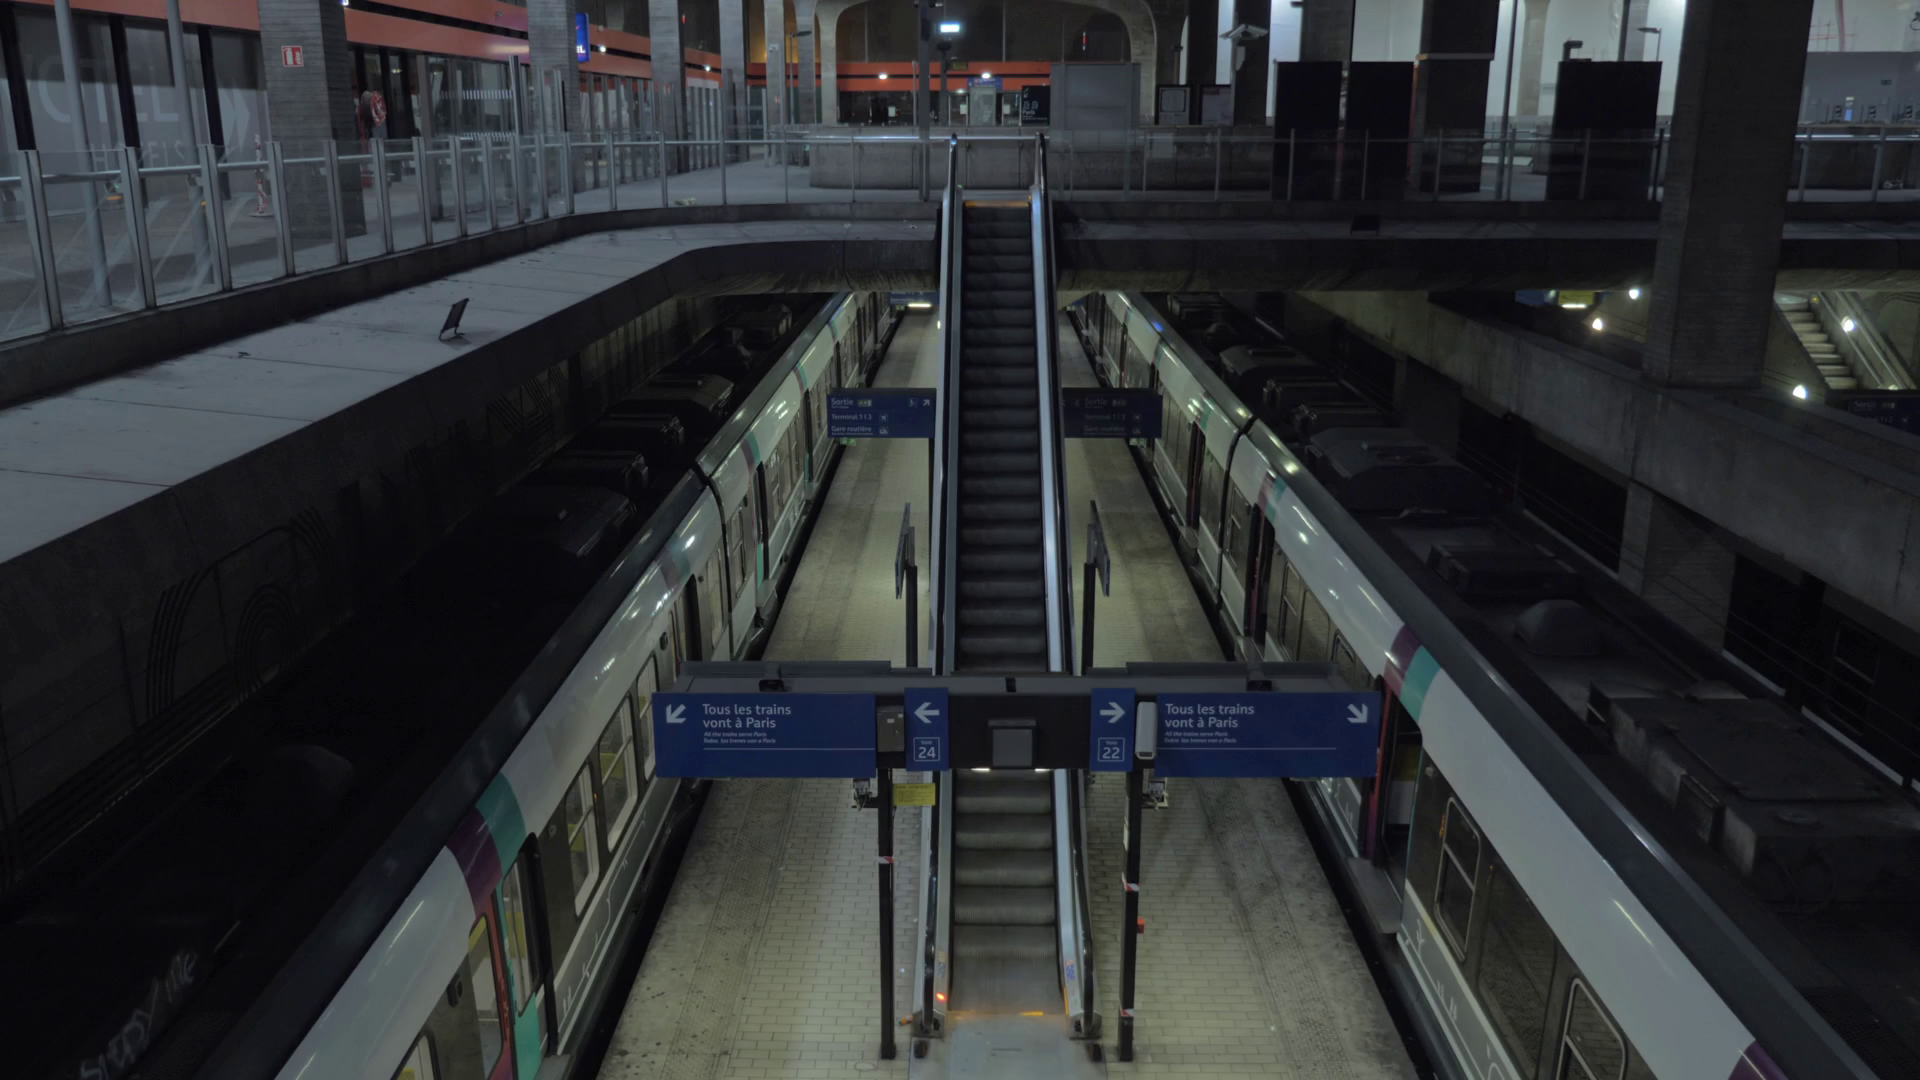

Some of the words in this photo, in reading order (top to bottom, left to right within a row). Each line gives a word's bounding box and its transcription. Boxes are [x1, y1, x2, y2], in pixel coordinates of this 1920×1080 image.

[831, 397, 854, 406] Sortie
[1084, 397, 1108, 406] Sortie
[702, 703, 731, 715] Tous
[734, 703, 752, 715] les
[755, 703, 792, 715] trains
[1165, 703, 1194, 715] Tous
[1197, 703, 1215, 715] les
[1218, 703, 1255, 715] trains
[702, 717, 732, 728] vont
[735, 717, 743, 728] à
[746, 717, 777, 728] Paris
[1164, 717, 1194, 728] vont
[1196, 717, 1205, 728] à
[1208, 716, 1239, 728] Paris
[918, 746, 936, 759] 24
[1102, 746, 1120, 759] 22
